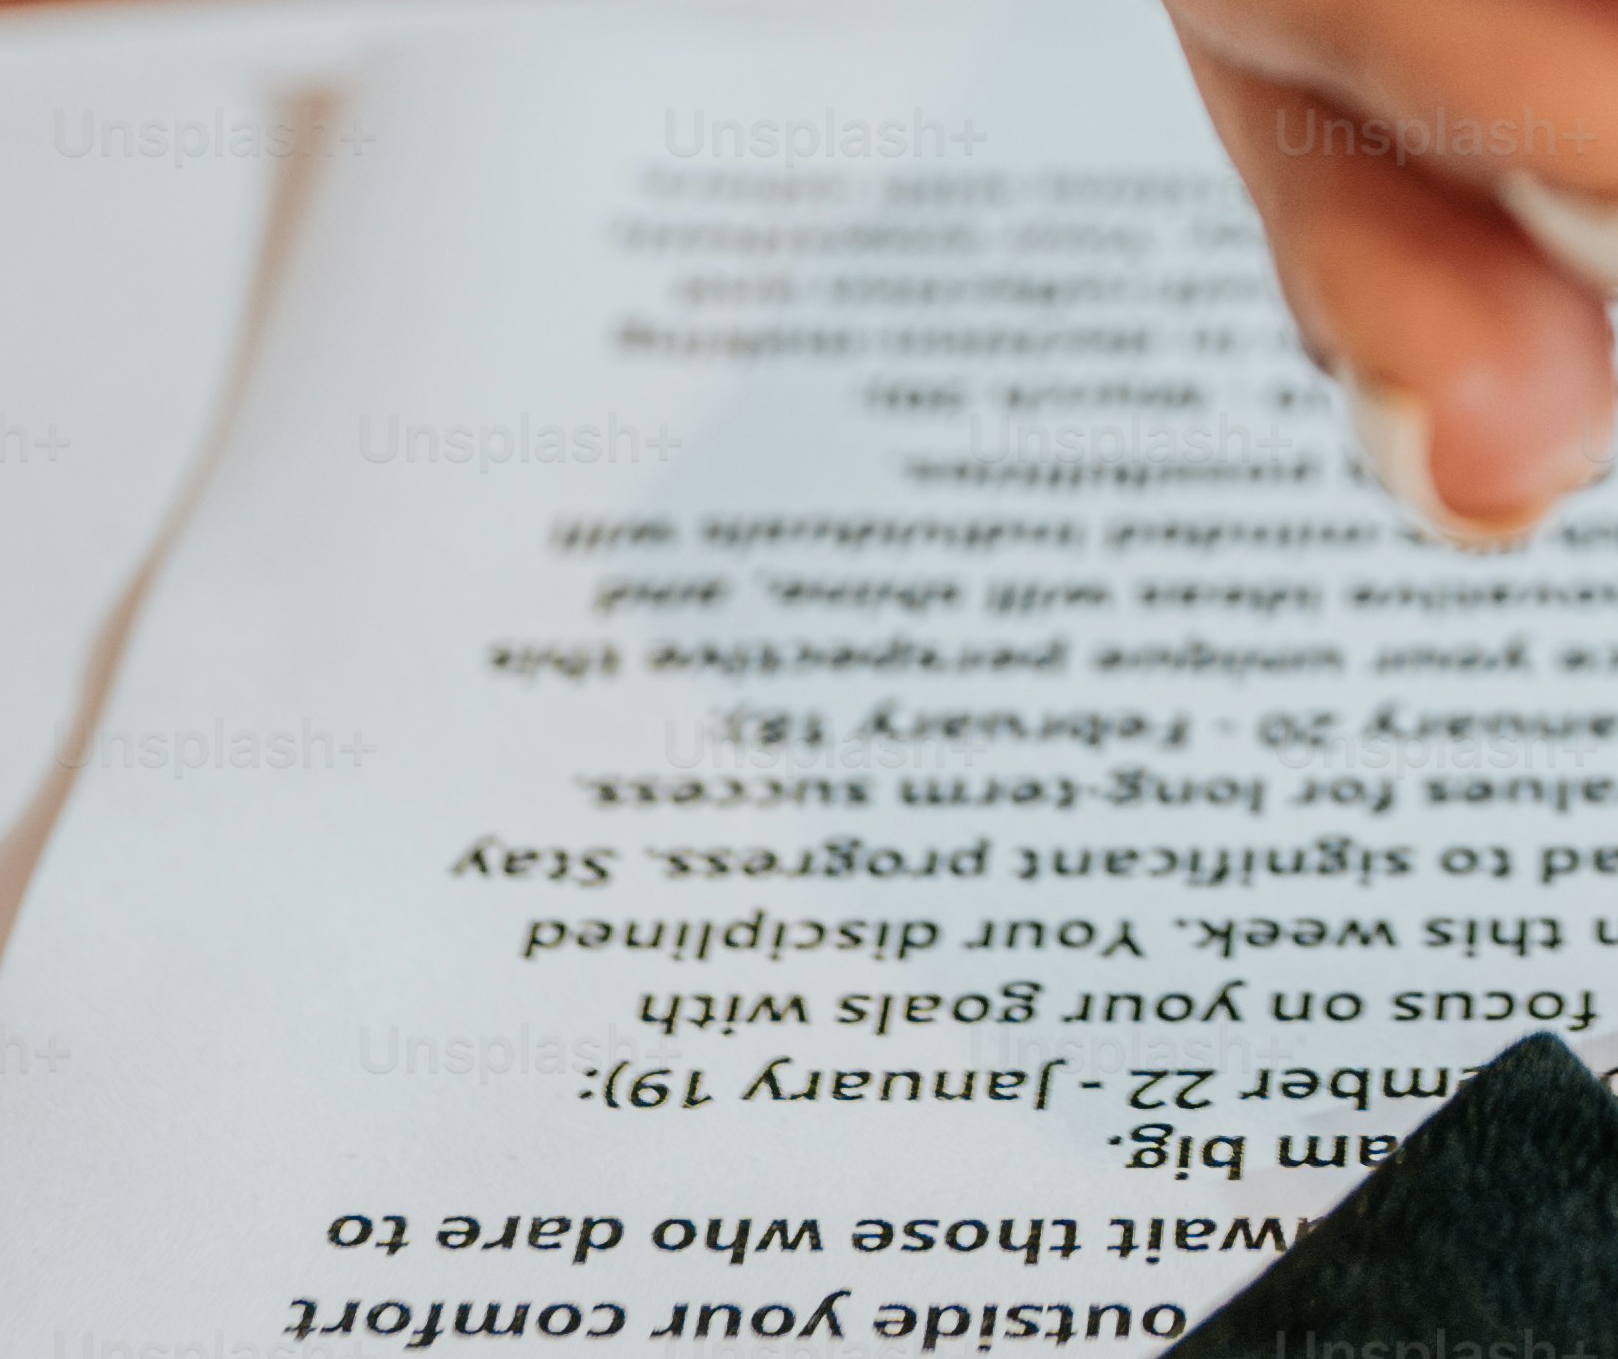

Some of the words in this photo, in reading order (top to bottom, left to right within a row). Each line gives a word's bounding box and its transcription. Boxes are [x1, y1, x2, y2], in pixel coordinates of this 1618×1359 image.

[452, 833, 619, 888] Stay
[646, 833, 992, 881] progress.
[1017, 837, 1413, 888] significant
[1438, 846, 1514, 880] to
[522, 909, 942, 961] disciplined
[964, 919, 1145, 958] Your
[1175, 918, 1398, 961] week.
[1424, 917, 1564, 958] this
[639, 994, 809, 1037] with
[837, 977, 1044, 1037] goals
[1061, 975, 1246, 1024] your
[1270, 992, 1365, 1023] on
[1392, 990, 1598, 1037] focus
[579, 1060, 712, 1109] 19):
[741, 1056, 1064, 1111] January
[1128, 1068, 1216, 1111] 22
[1108, 1122, 1246, 1181] big.
[327, 1214, 408, 1256] to
[436, 1215, 624, 1264] dare
[652, 1218, 823, 1265] who
[851, 1218, 1081, 1266] those
[1107, 1217, 1314, 1266] wait
[284, 1298, 626, 1350] comfort
[650, 1288, 851, 1339] your
[873, 1302, 1187, 1355] outside
